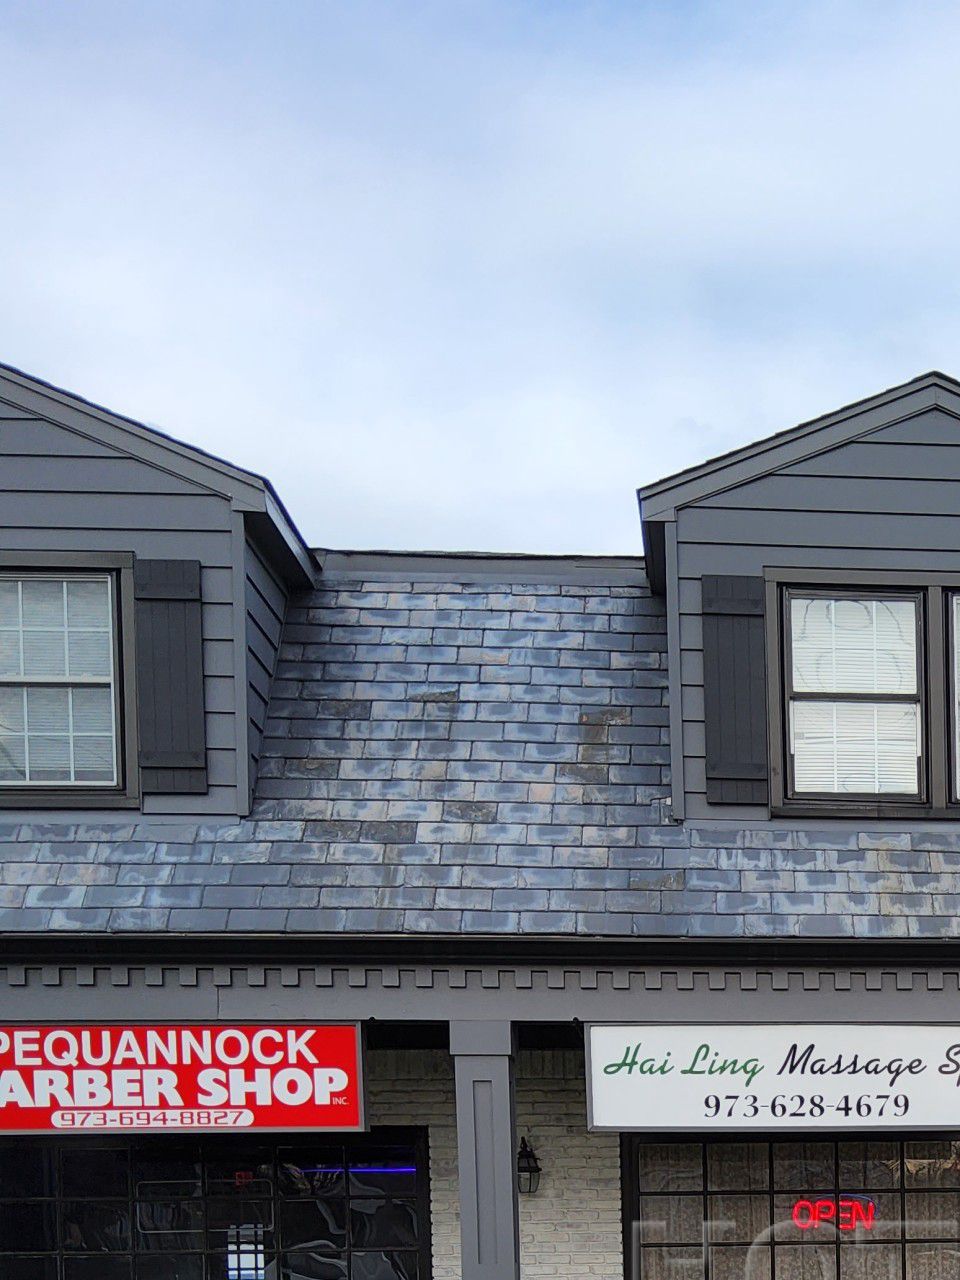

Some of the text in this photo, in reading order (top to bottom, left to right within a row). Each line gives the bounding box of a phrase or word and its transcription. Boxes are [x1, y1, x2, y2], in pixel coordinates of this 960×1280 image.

[603, 1042, 675, 1076] Hai
[680, 1043, 765, 1087] Ling
[776, 1043, 927, 1087] Massage
[197, 1067, 349, 1106] SHOP
[60, 1111, 243, 1127] 973-694-8827
[704, 1094, 910, 1118] 973-628-4679
[792, 1199, 875, 1230] OPEN
